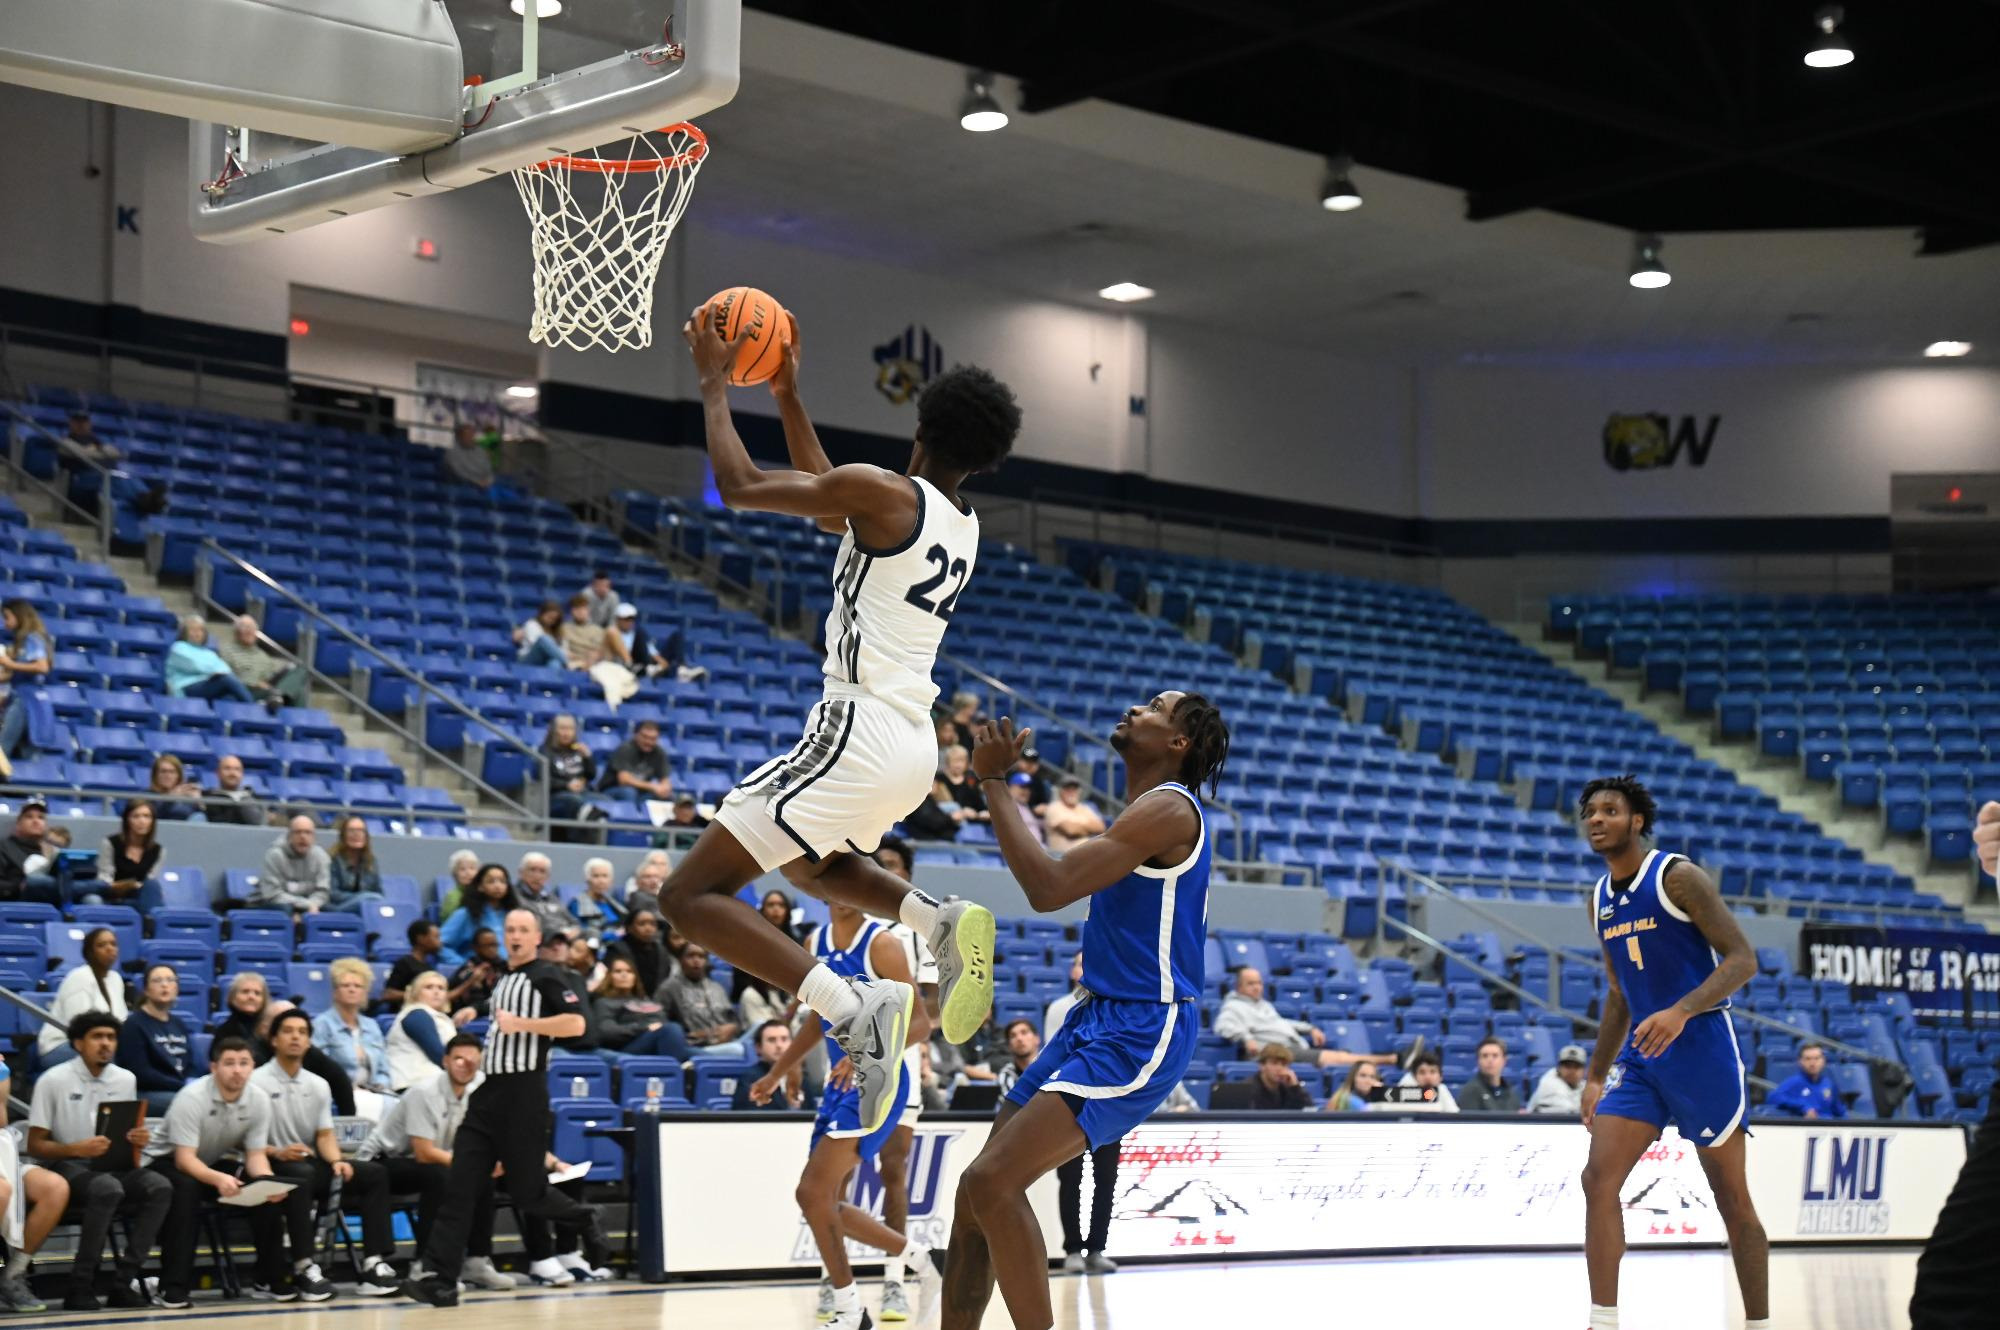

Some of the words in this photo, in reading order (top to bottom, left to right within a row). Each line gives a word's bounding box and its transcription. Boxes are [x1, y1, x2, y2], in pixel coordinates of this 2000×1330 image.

[117, 204, 139, 235] K
[904, 542, 968, 622] 22
[1603, 922, 1633, 941] MARS
[1634, 917, 1658, 932] HILL
[1626, 935, 1644, 971] 4
[1802, 1133, 1892, 1201] LMU
[1797, 1202, 1891, 1234] ATHLETICS
